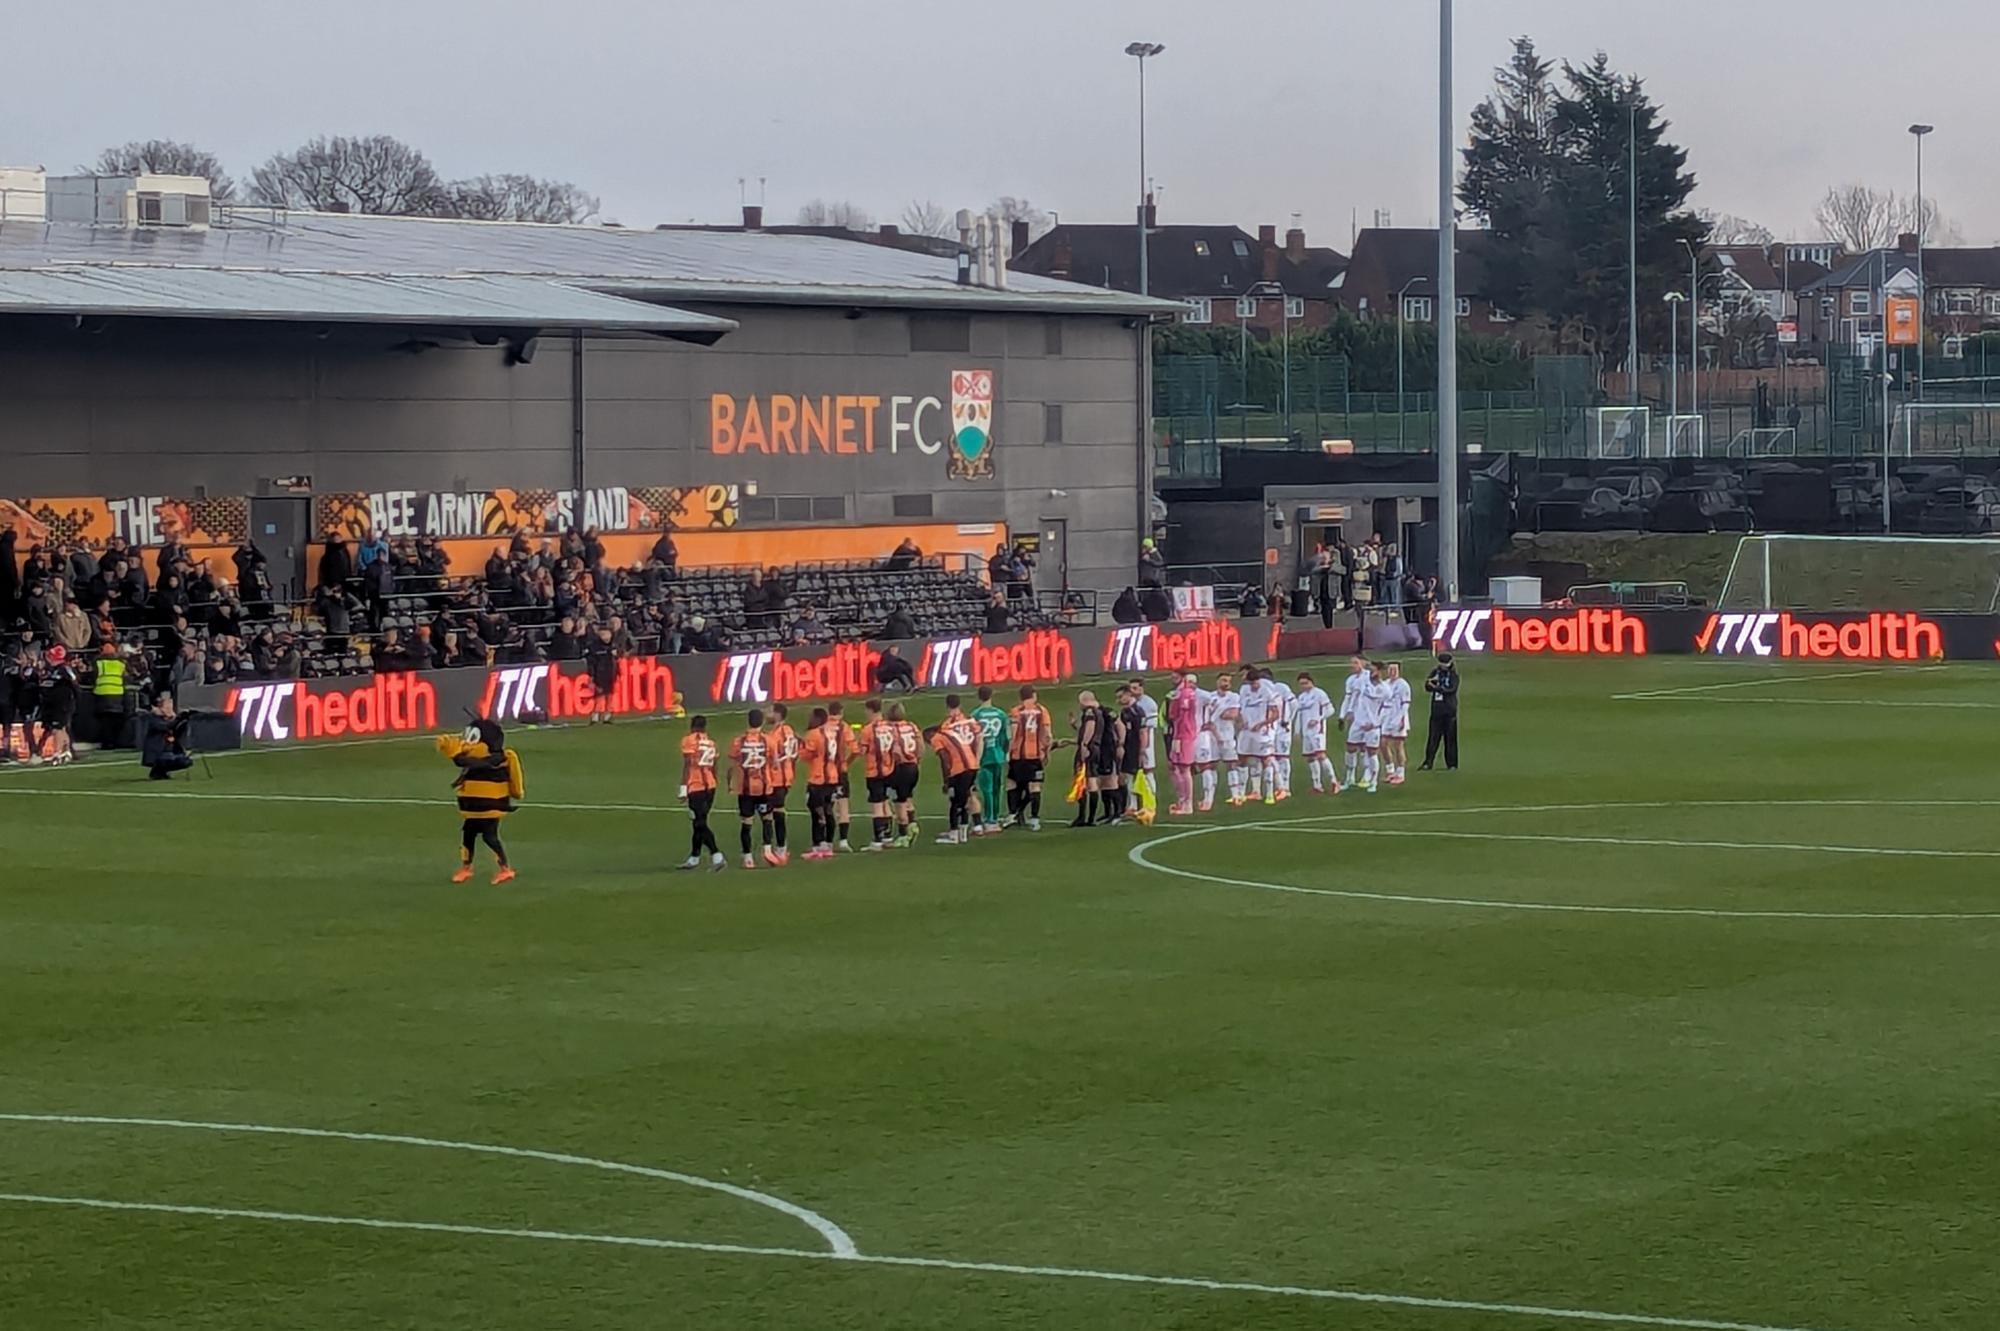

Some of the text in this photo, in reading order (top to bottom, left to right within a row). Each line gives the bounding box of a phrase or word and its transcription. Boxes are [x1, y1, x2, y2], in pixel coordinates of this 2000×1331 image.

[711, 393, 943, 455] BARNET FC
[107, 486, 629, 546] THE BEE ARMY SAND
[931, 629, 1073, 687] TIC health
[1113, 619, 1242, 672] TIC health
[1432, 608, 1646, 654] TIC health
[1715, 612, 1942, 660] TIC health
[496, 665, 550, 720] TIC
[726, 651, 774, 703] TIC
[239, 671, 436, 740] TIC health
[1025, 715, 1038, 733] 4
